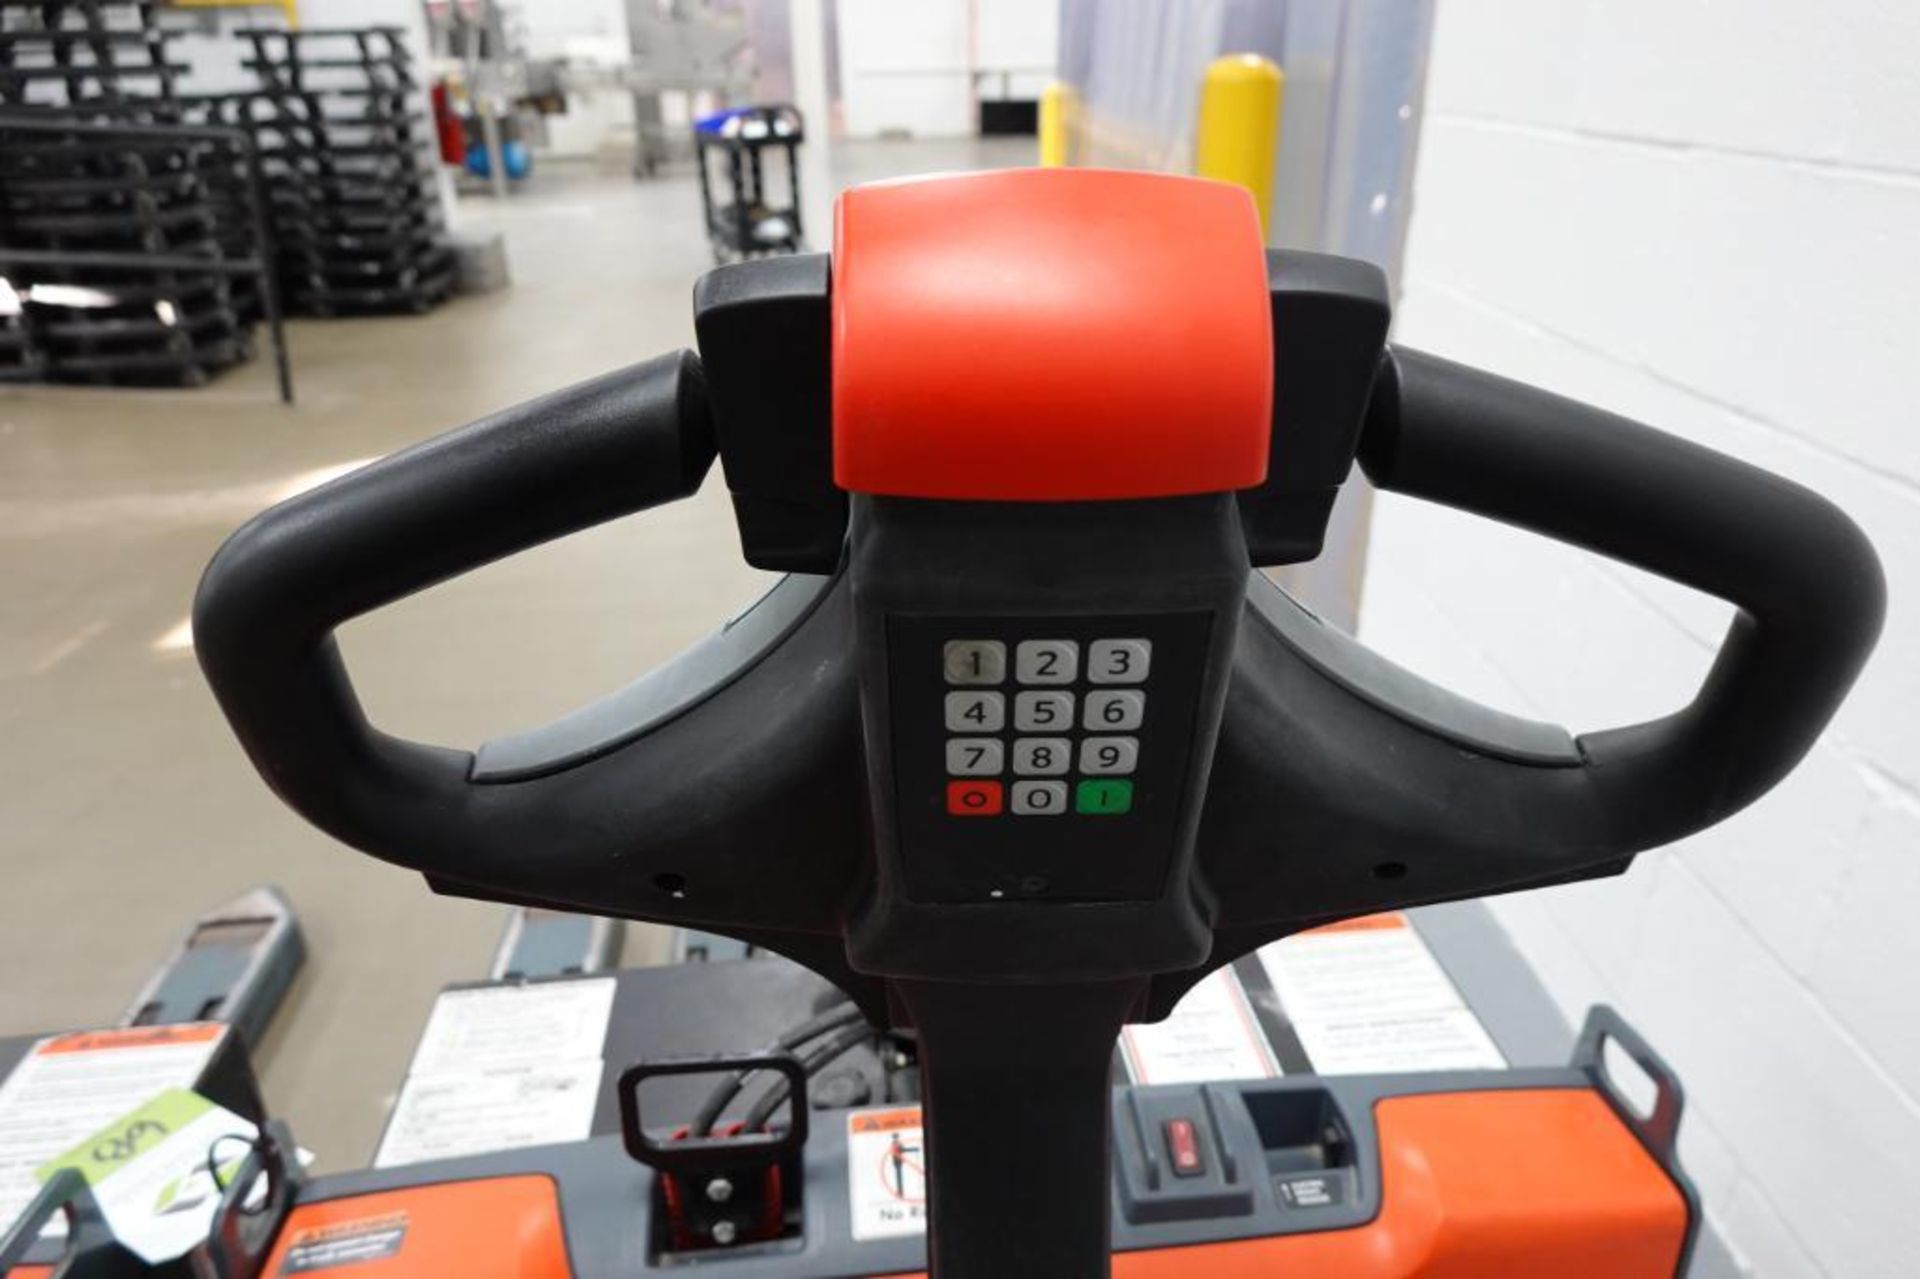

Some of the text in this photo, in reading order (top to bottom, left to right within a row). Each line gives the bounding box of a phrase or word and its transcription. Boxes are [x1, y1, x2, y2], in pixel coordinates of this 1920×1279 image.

[970, 650, 1130, 676] 1 2 3
[964, 700, 1125, 724] 4 5 6
[963, 746, 1120, 768] 7 8 9
